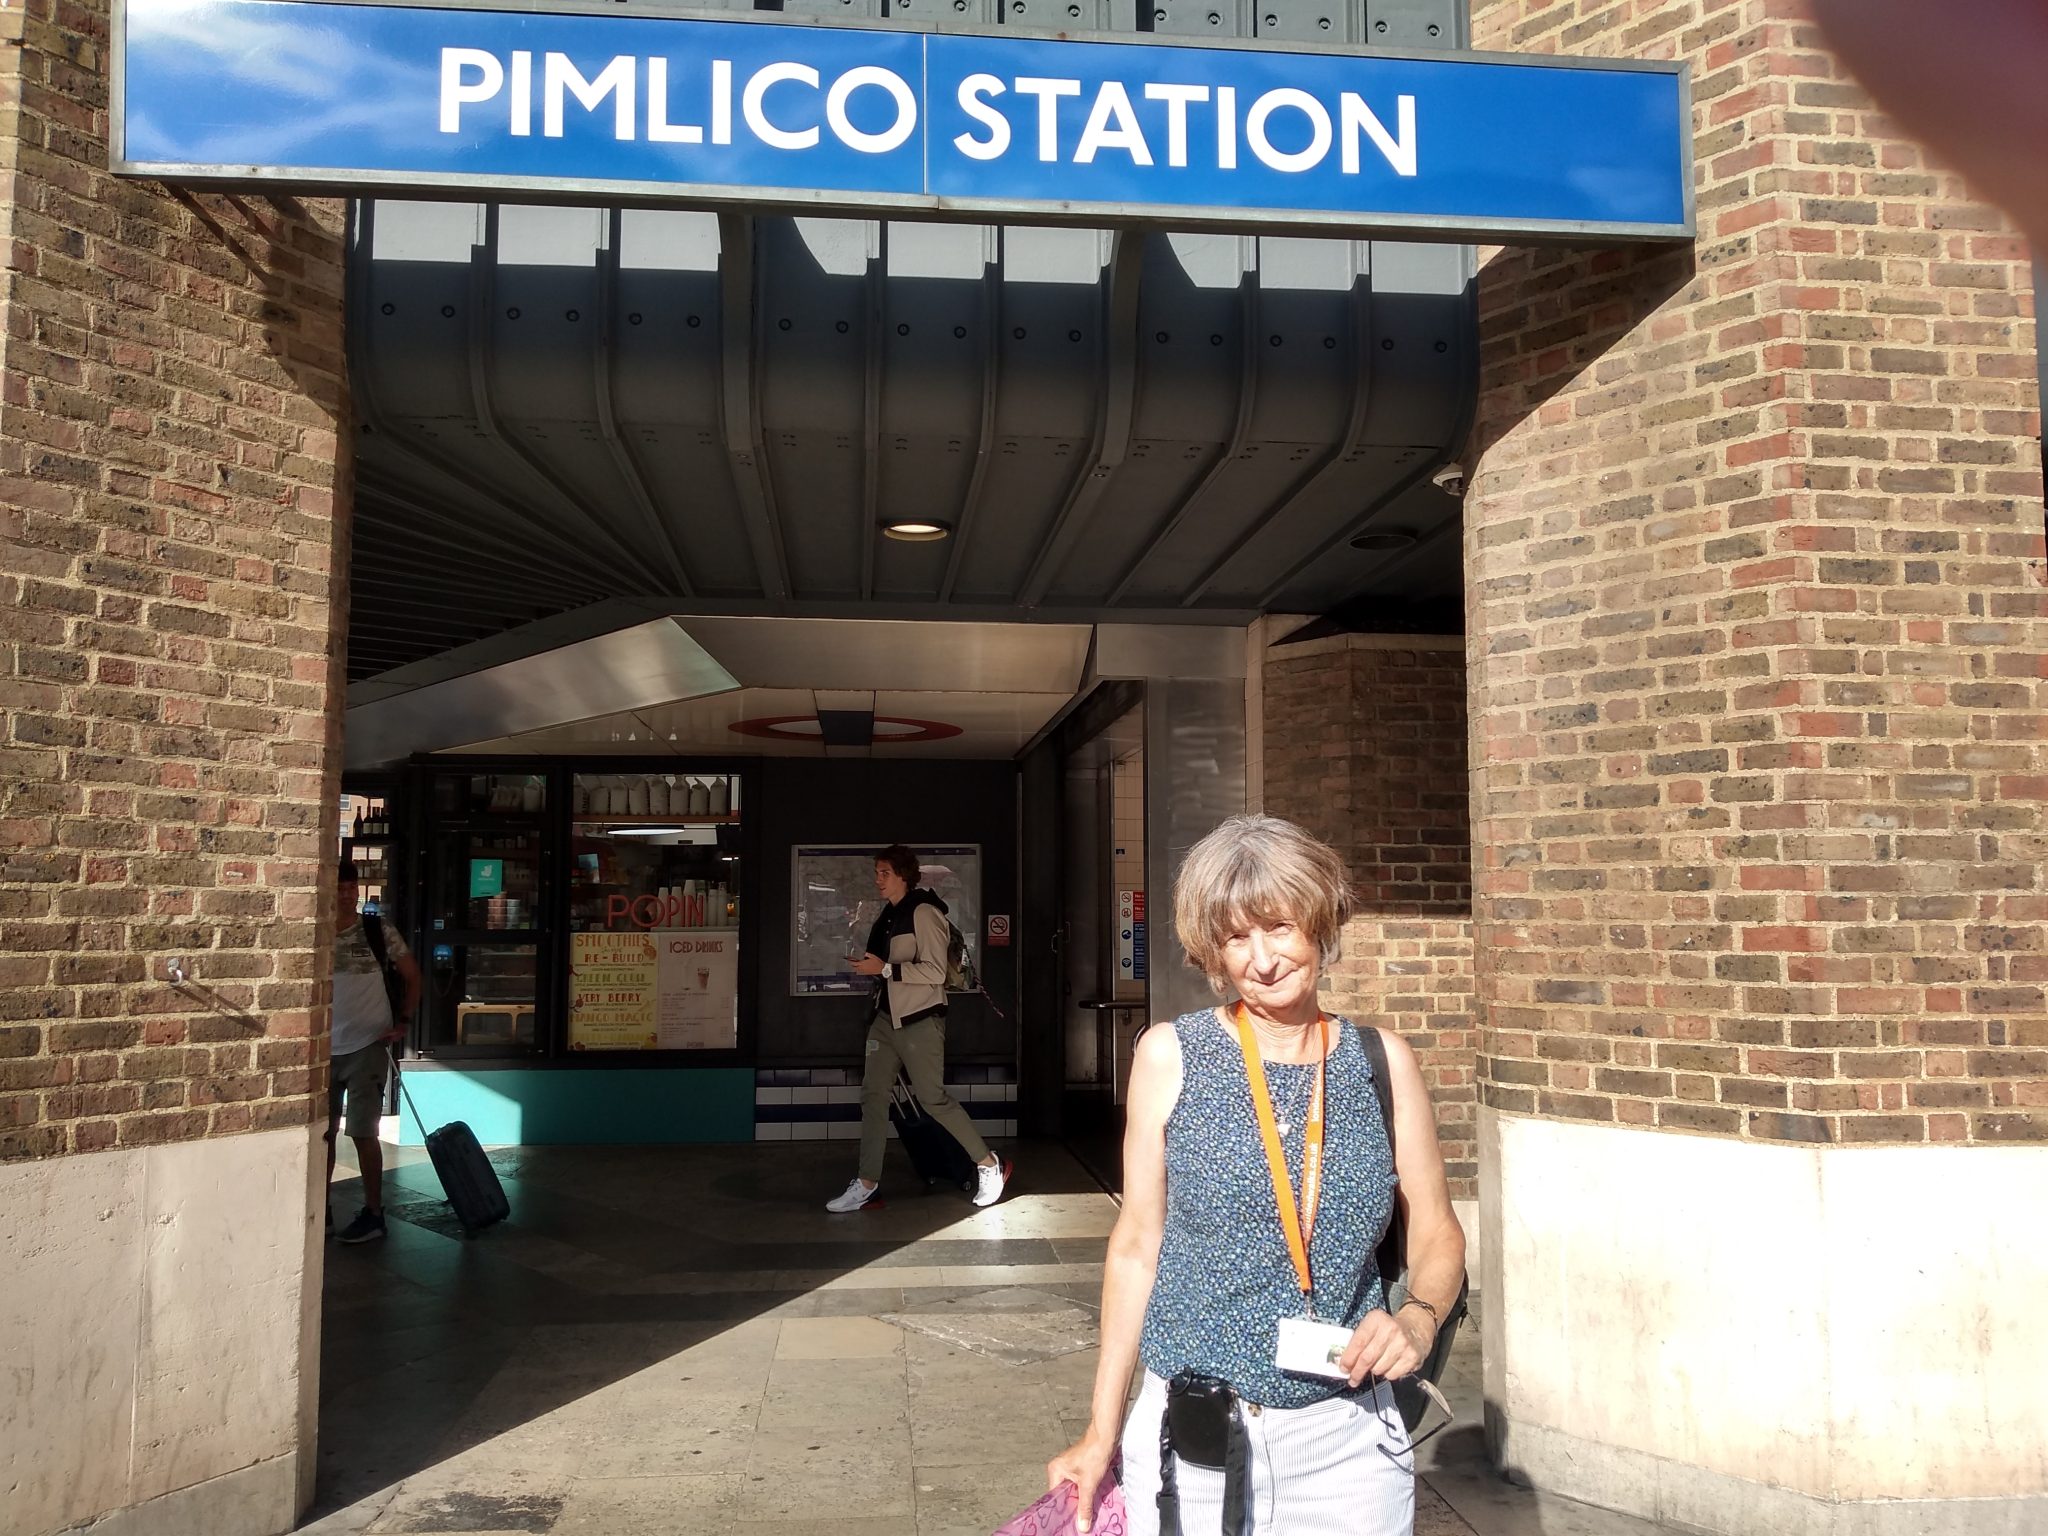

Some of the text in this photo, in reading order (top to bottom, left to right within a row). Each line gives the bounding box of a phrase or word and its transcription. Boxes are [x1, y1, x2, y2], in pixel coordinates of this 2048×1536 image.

[439, 47, 1417, 177] PIMLICO STATION
[607, 894, 704, 928] POPIN
[669, 941, 723, 954] ICED DRINKS
[577, 993, 641, 1002] VERY BERRY
